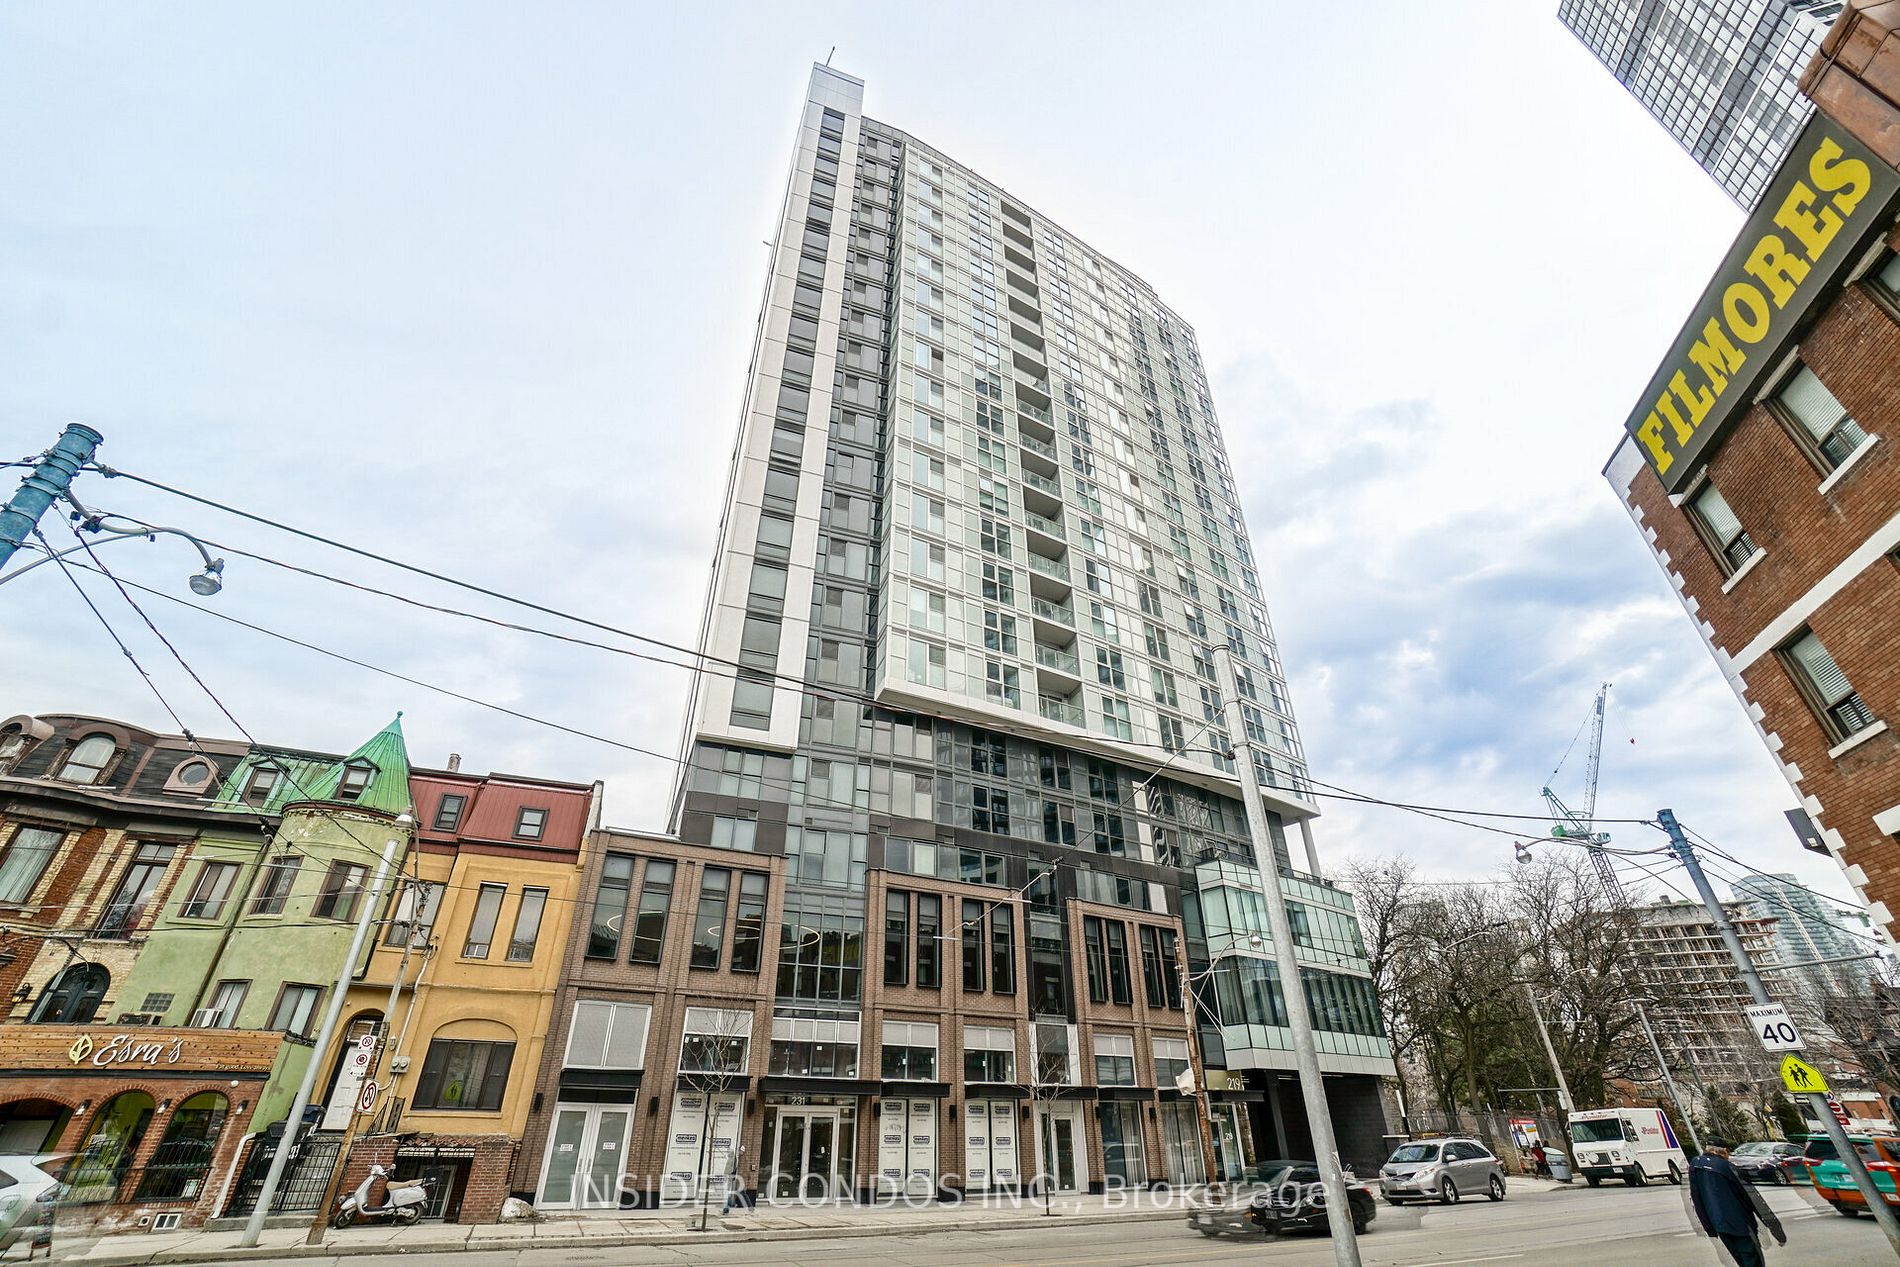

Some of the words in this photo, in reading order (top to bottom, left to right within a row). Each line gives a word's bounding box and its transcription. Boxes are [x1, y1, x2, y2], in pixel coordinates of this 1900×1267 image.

[1637, 136, 1872, 476] FILMORES
[1750, 1008, 1784, 1017] MAXIMUM
[1763, 1022, 1797, 1044] 40
[93, 1033, 185, 1067] Esra's
[1227, 1077, 1240, 1090] 219
[791, 1096, 805, 1105] 231
